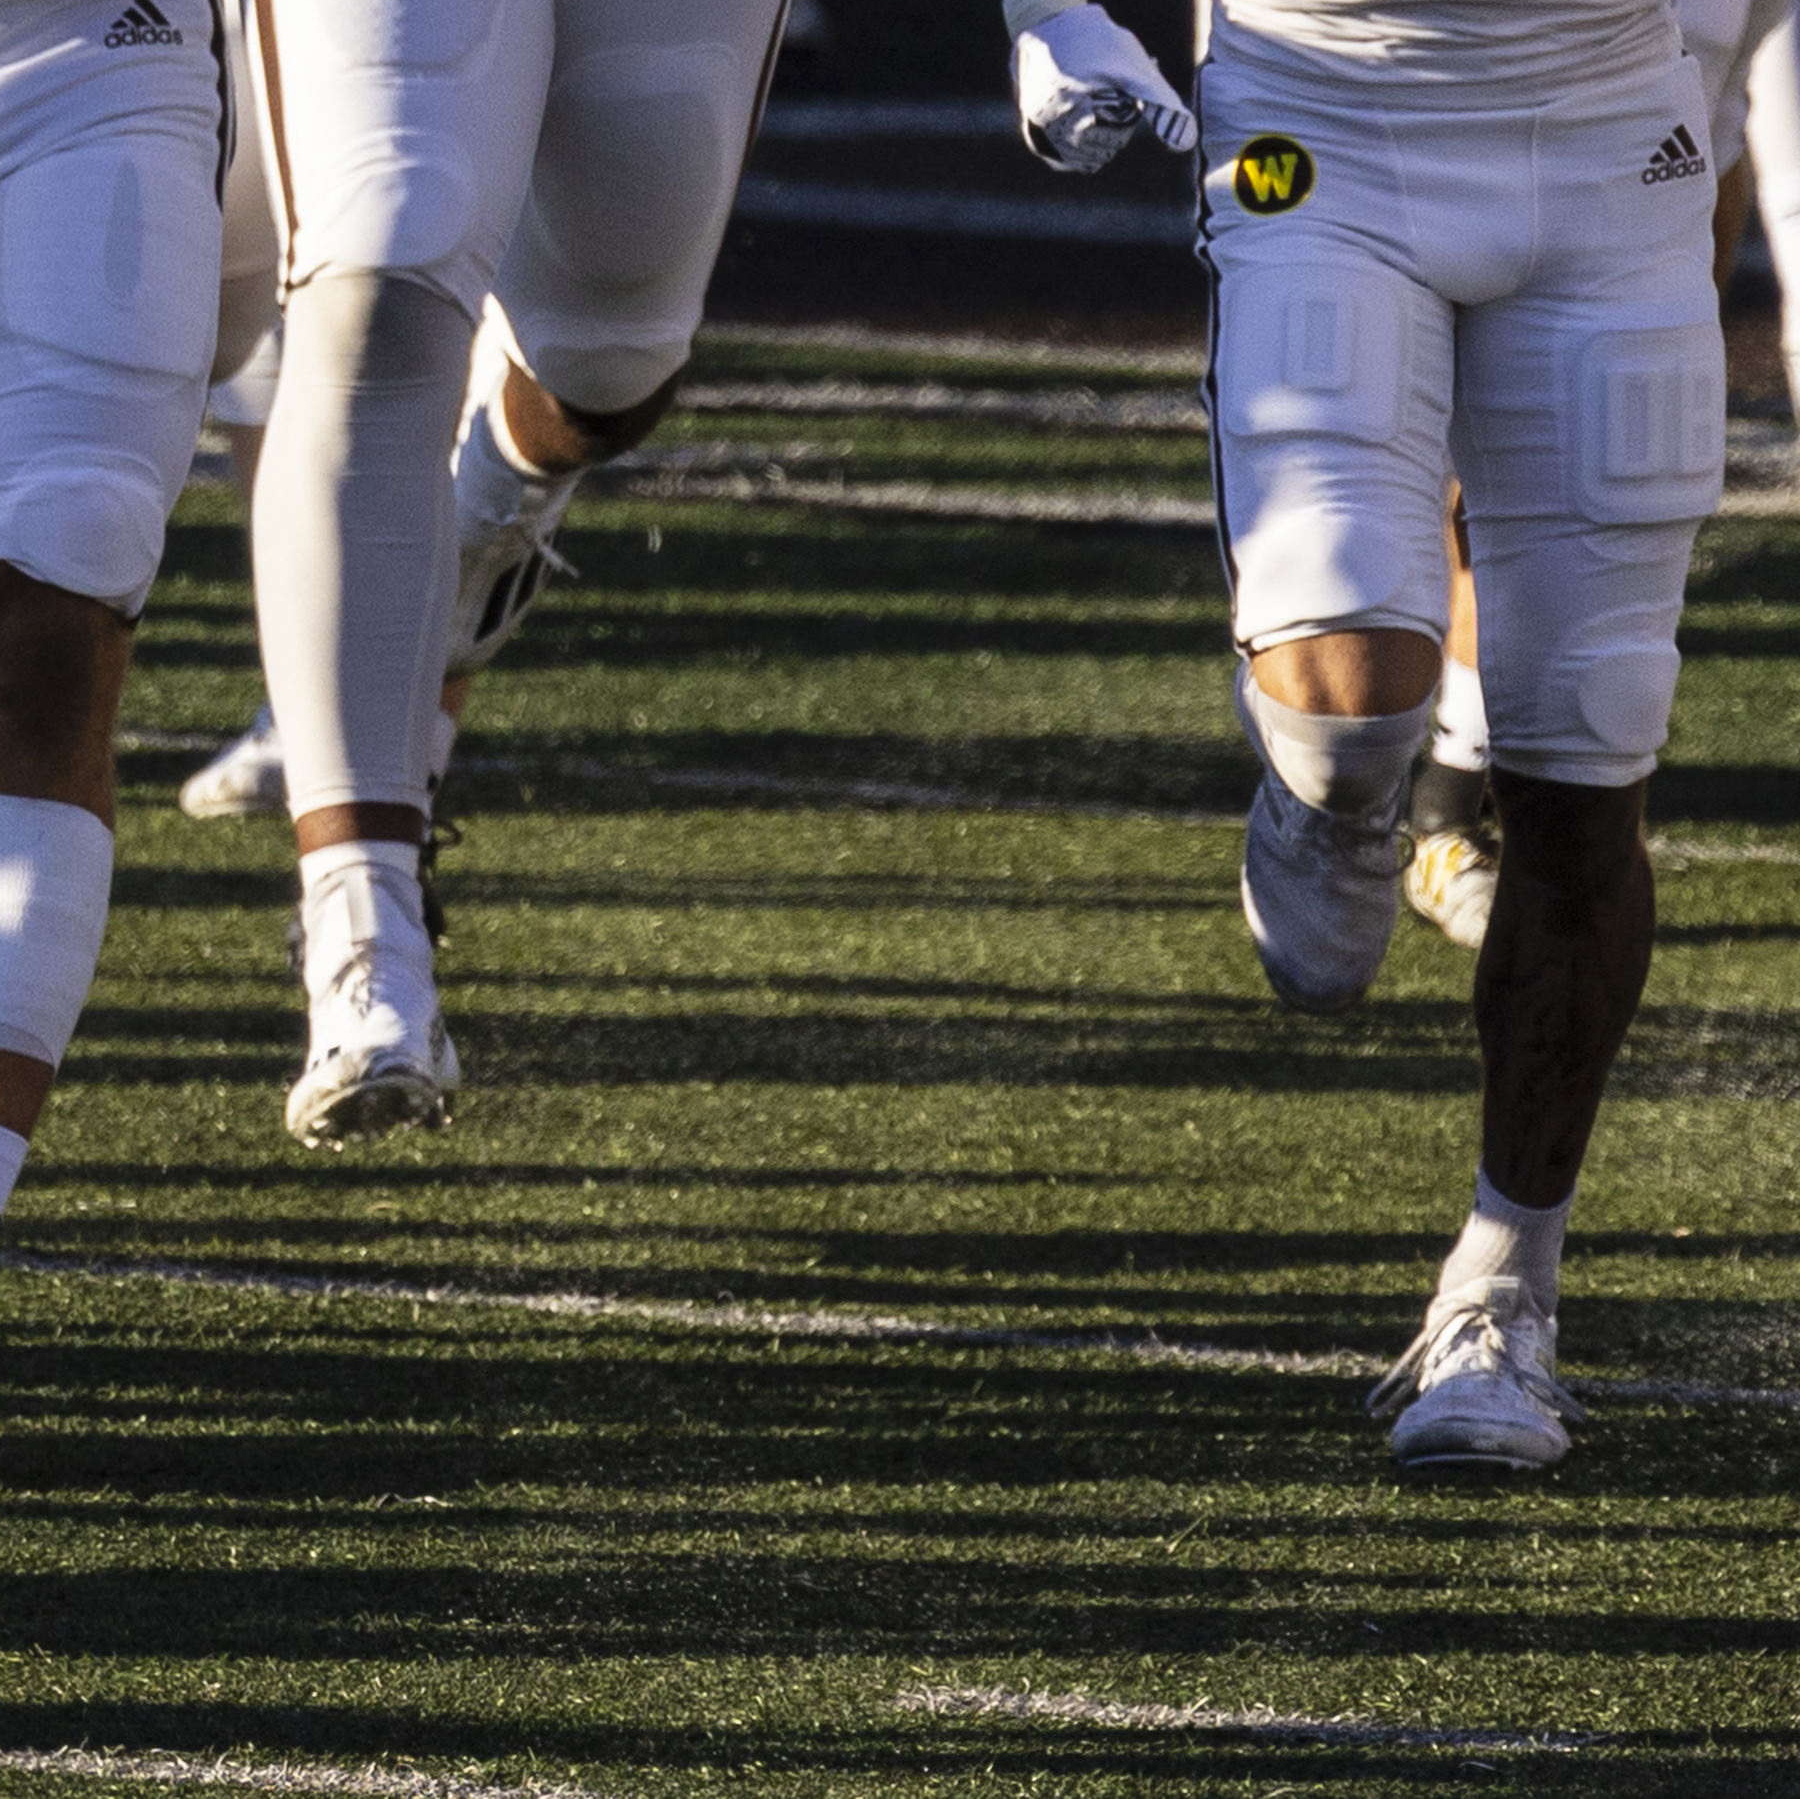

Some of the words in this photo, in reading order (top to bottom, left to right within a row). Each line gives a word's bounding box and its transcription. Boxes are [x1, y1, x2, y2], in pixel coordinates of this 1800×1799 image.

[104, 24, 183, 49] adidas
[1243, 153, 1298, 202] W
[1641, 153, 1706, 186] adidas
